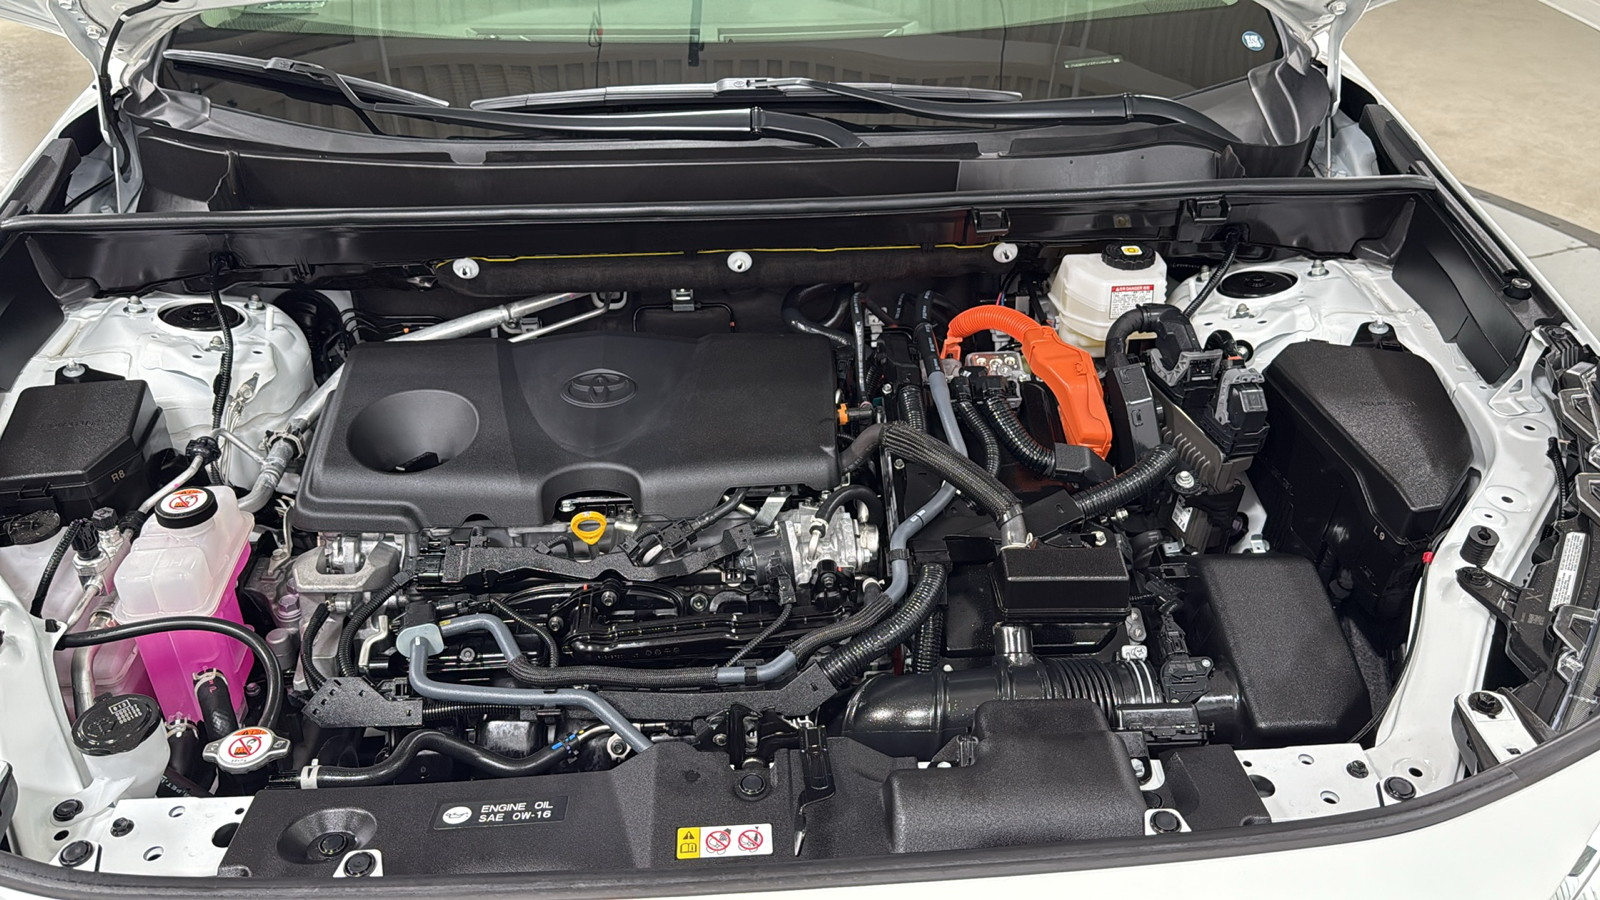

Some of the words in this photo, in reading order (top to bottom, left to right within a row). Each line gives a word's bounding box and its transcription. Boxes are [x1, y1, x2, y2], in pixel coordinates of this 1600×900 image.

[111, 469, 126, 483] R8
[481, 802, 527, 813] ENGINE
[534, 801, 554, 810] OIL
[478, 813, 505, 823] SAE
[512, 810, 552, 821] 0W-16
